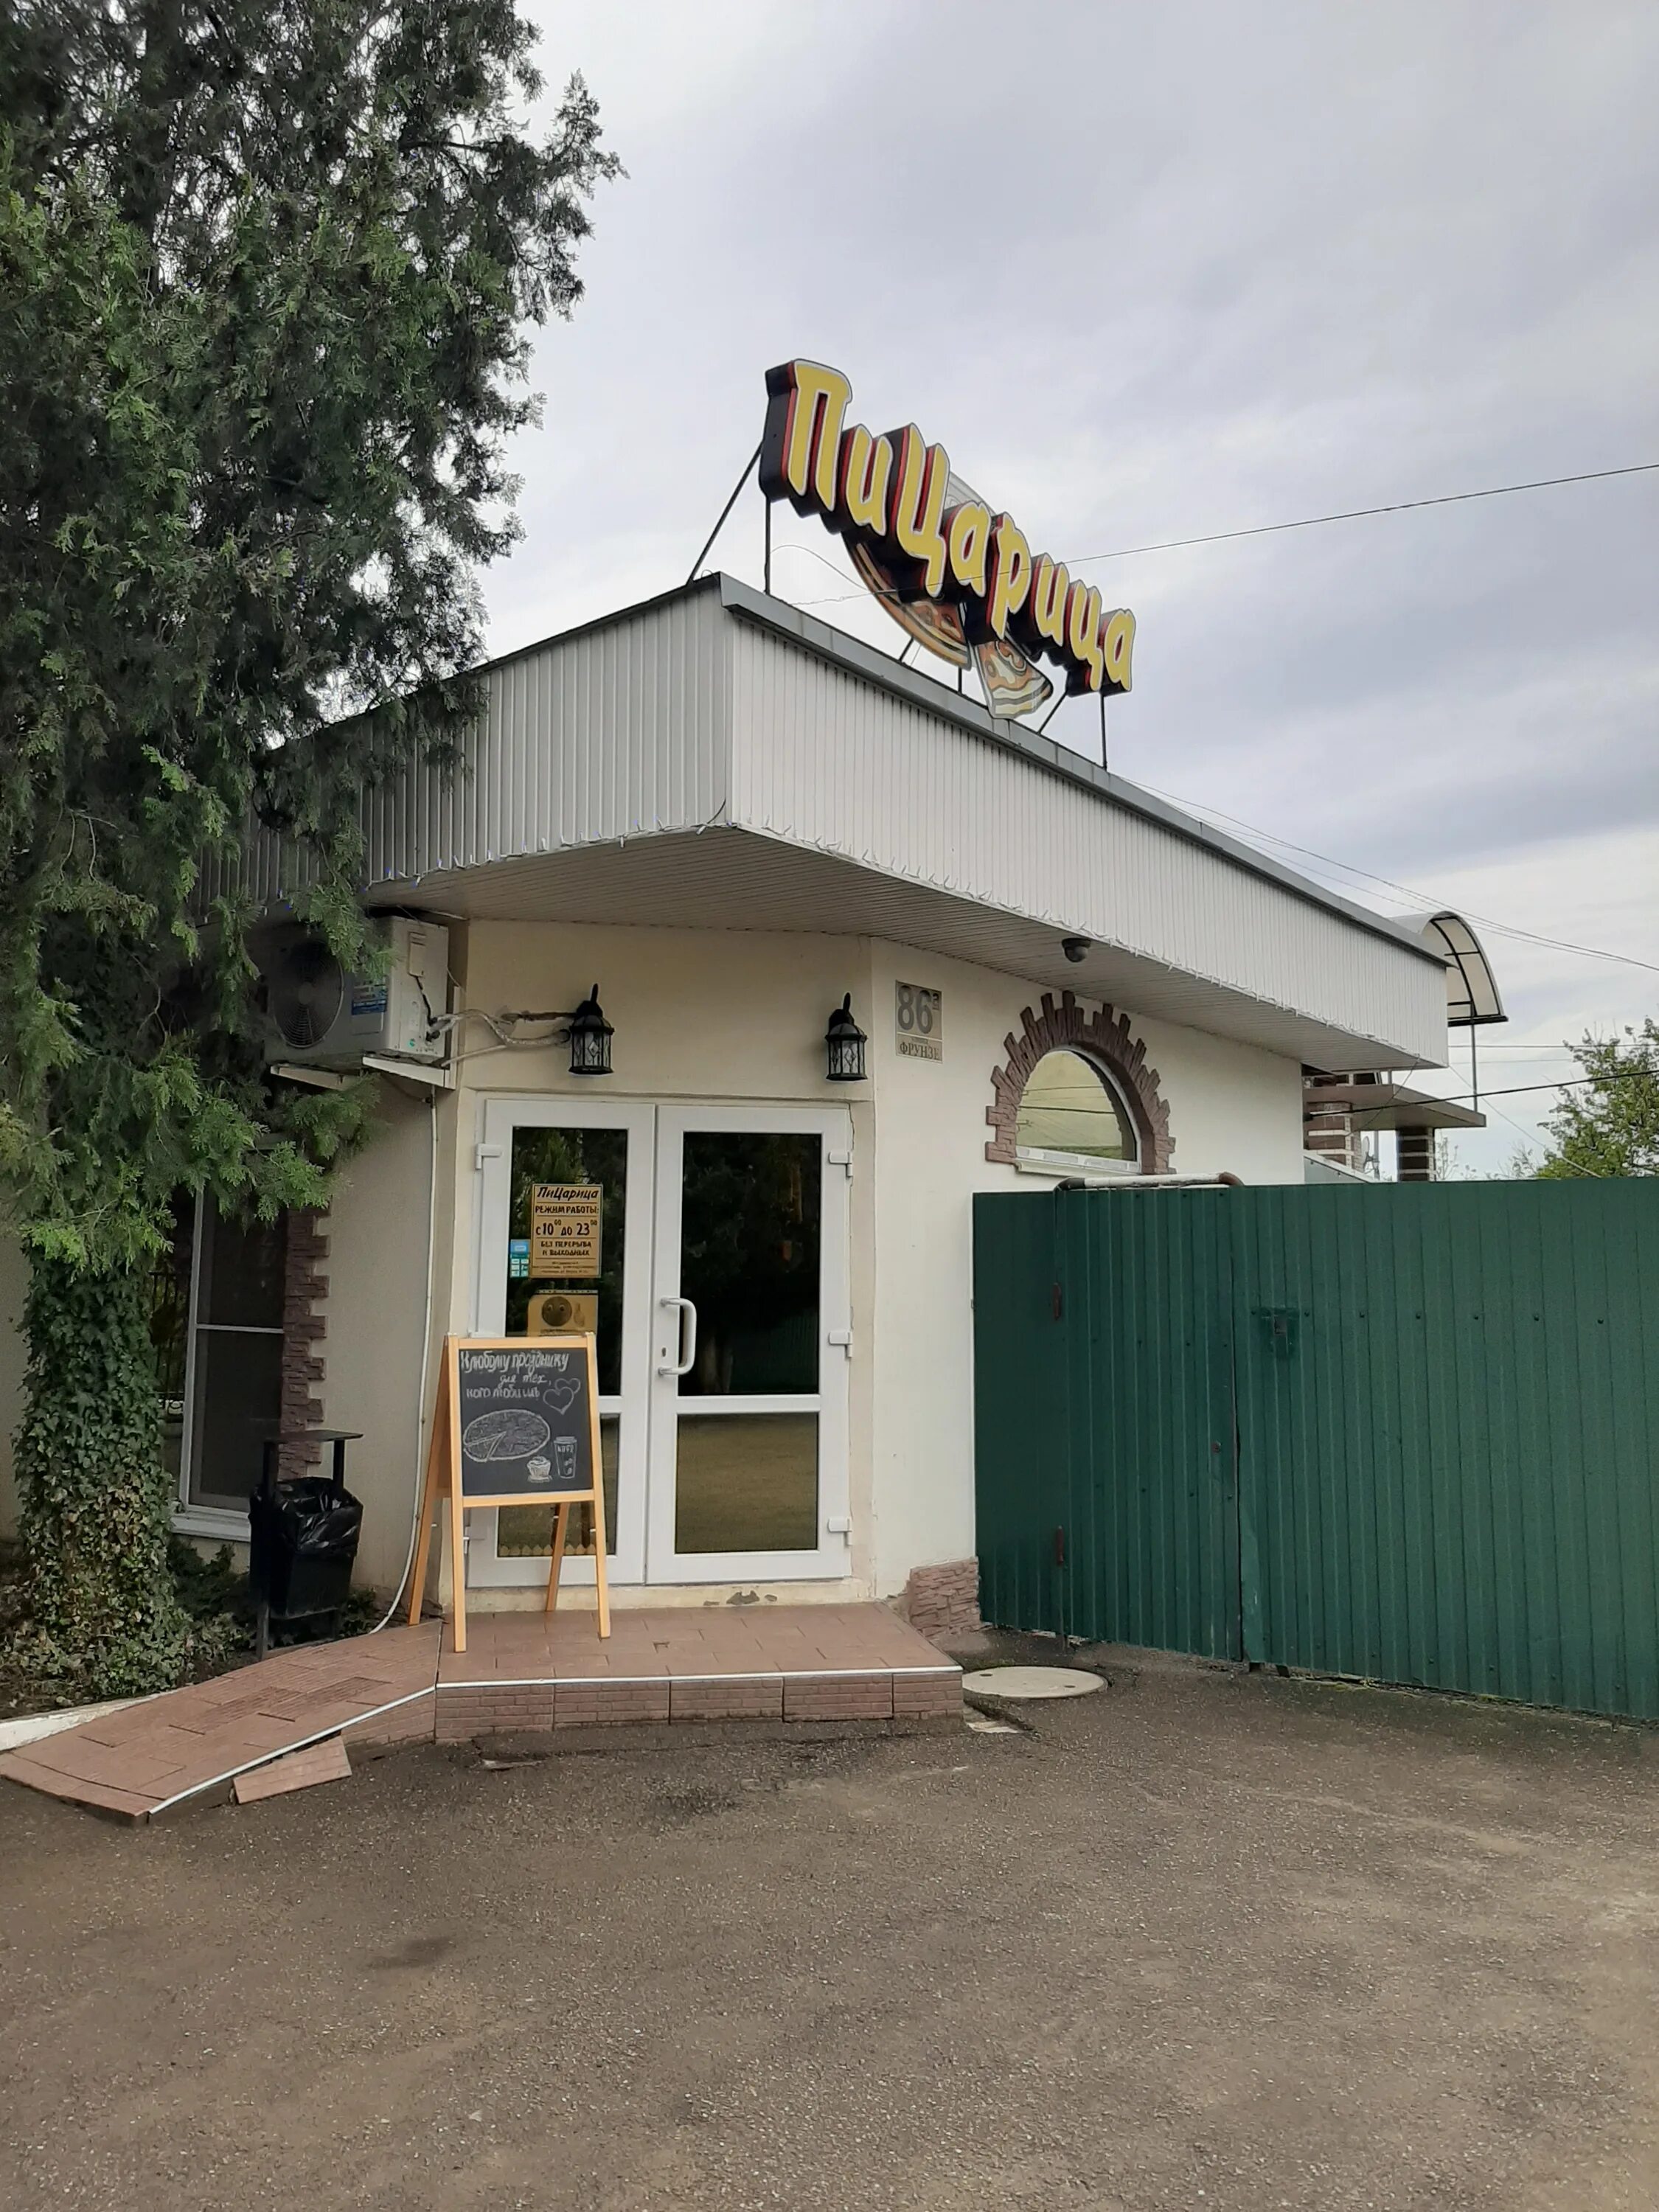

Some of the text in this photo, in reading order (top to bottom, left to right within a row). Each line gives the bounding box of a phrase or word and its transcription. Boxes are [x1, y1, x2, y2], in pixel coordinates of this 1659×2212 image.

[782, 358, 1136, 693] ПиЦарица
[898, 985, 933, 1034] 86
[900, 1041, 939, 1060] ФРУНЗЕ
[537, 1186, 599, 1201] ПиЦарица
[535, 1205, 565, 1214] РЕЖИМ
